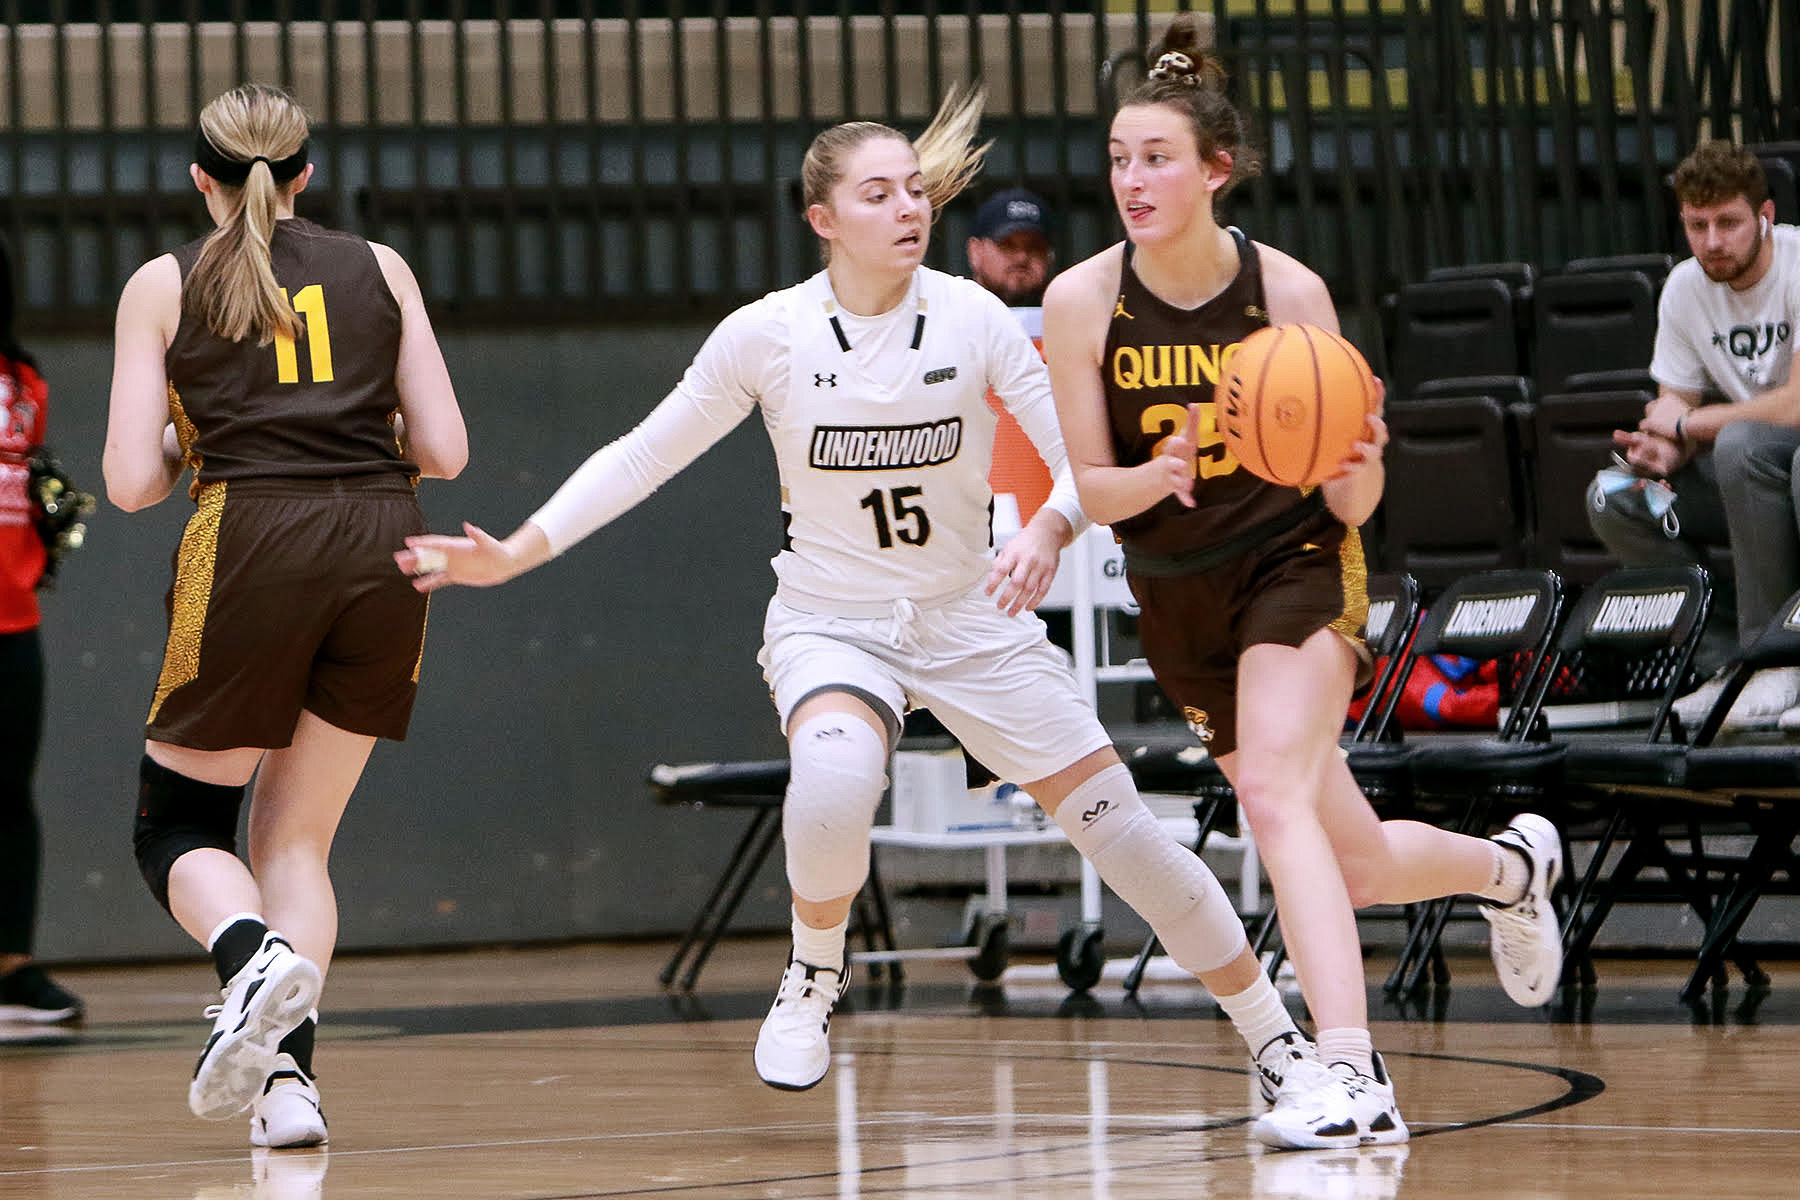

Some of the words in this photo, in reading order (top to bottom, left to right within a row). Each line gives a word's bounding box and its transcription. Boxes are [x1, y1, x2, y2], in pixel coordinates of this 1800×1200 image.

[274, 284, 335, 384] 11
[812, 420, 961, 468] LINDENWOOD
[1141, 402, 1242, 479] 25
[860, 485, 931, 549] 15
